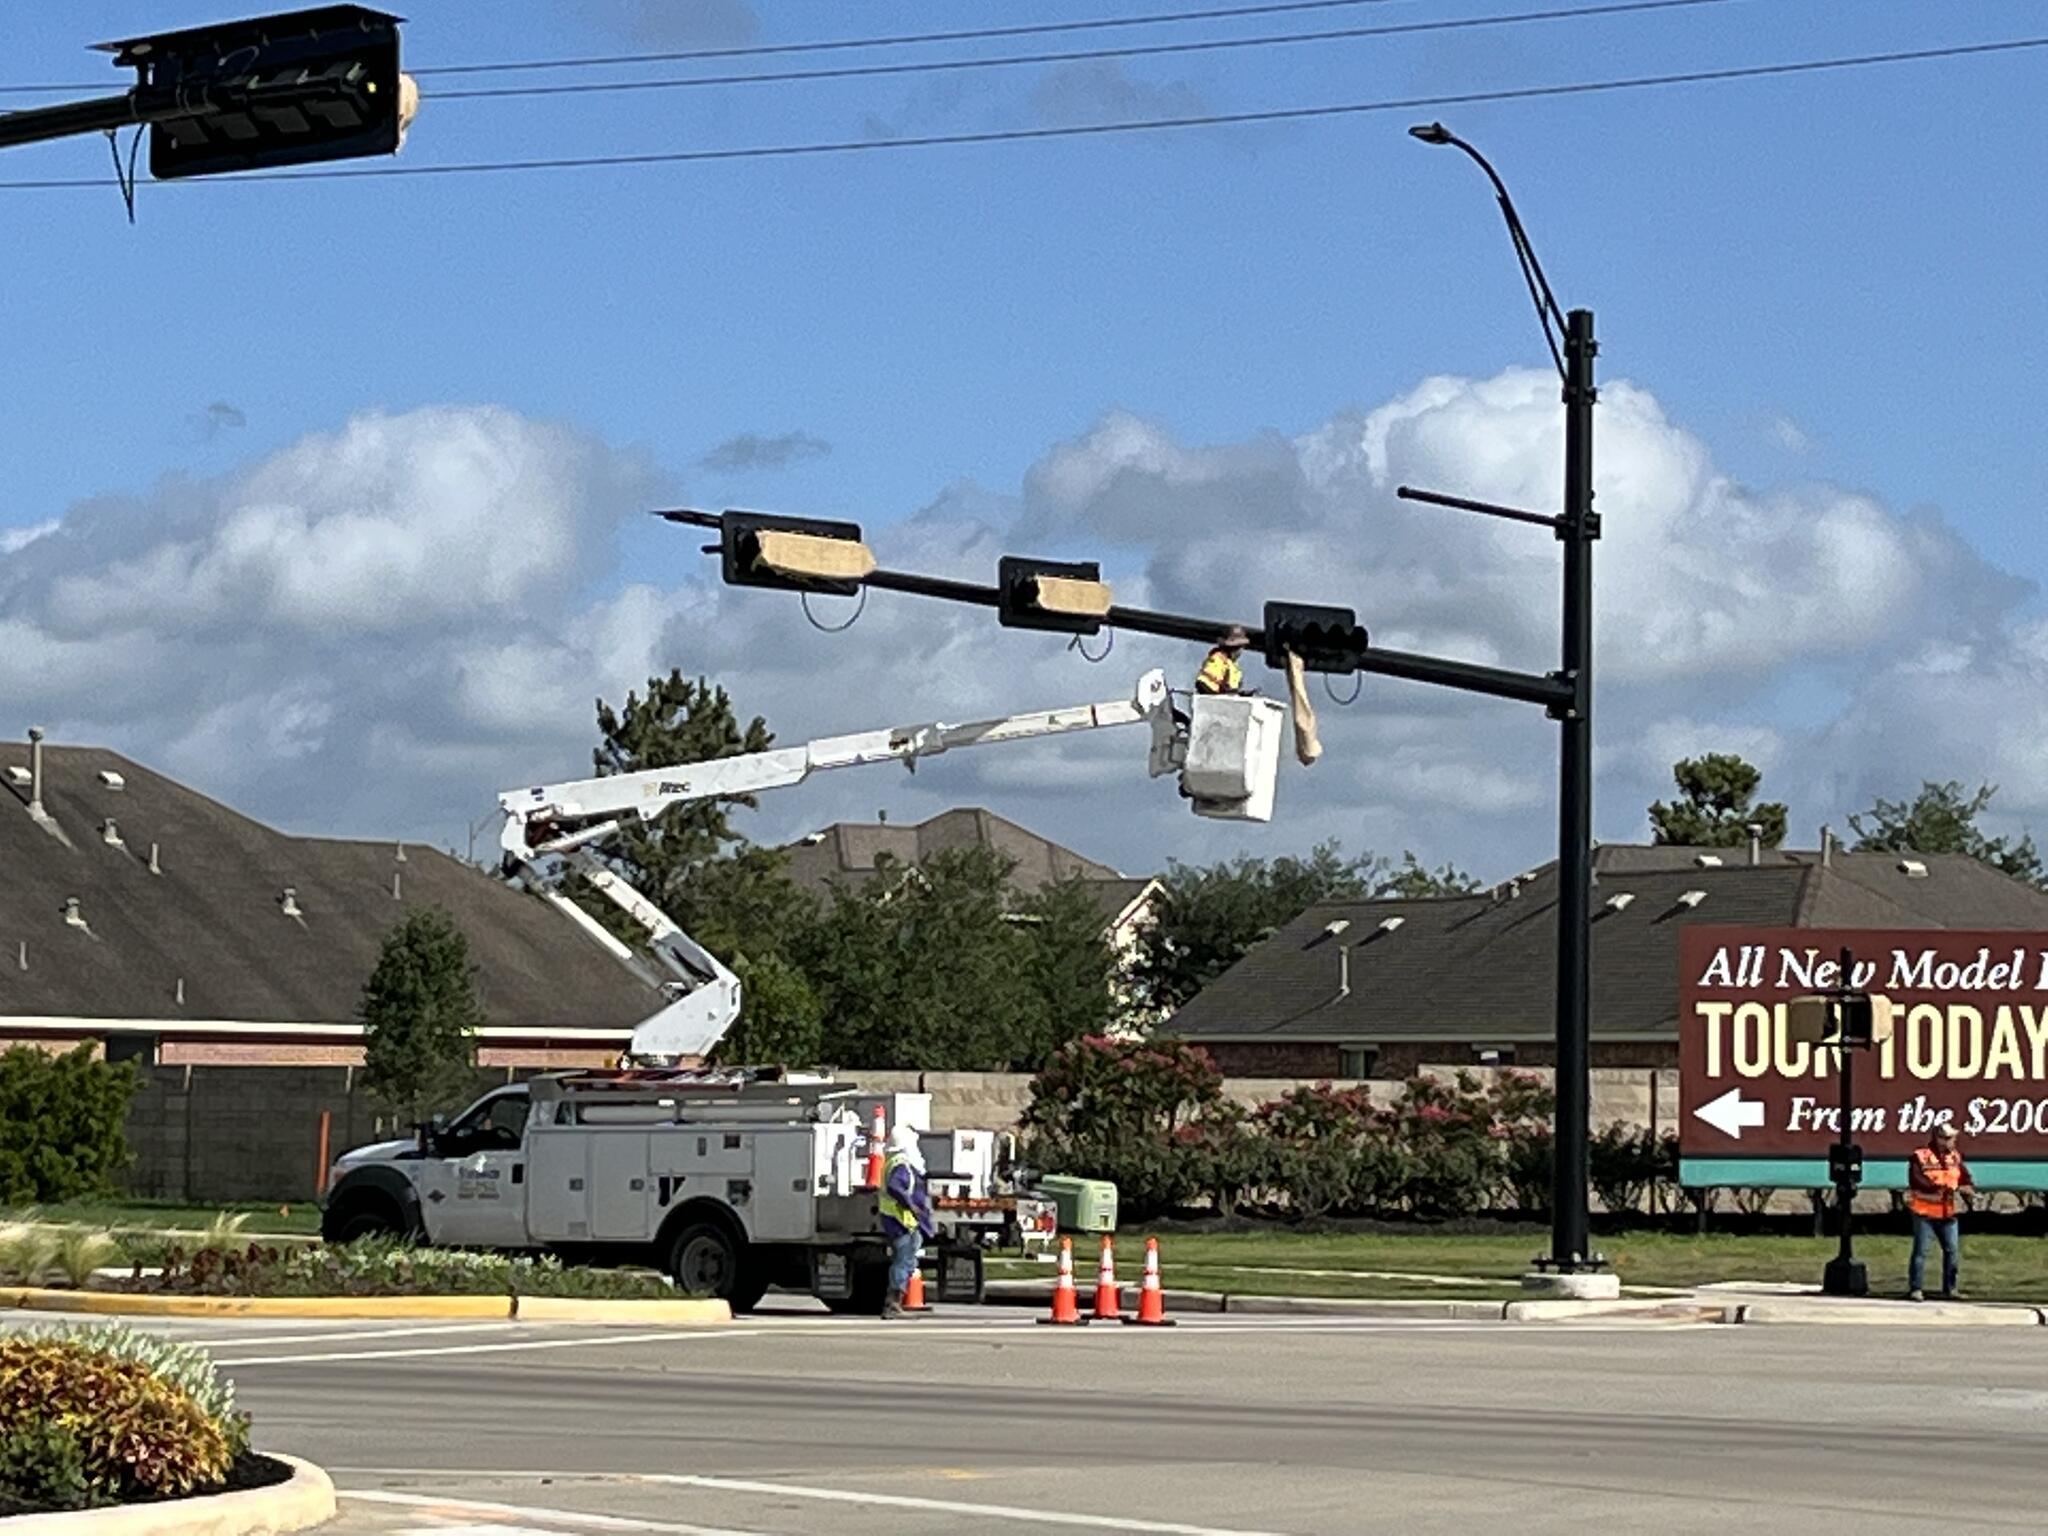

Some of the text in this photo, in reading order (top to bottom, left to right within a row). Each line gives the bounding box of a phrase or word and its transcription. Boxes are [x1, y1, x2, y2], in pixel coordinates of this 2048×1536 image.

[1698, 946, 1765, 988] All
[1886, 948, 2025, 990] Model
[1786, 1097, 1886, 1132] From
[1897, 1095, 1954, 1133] the
